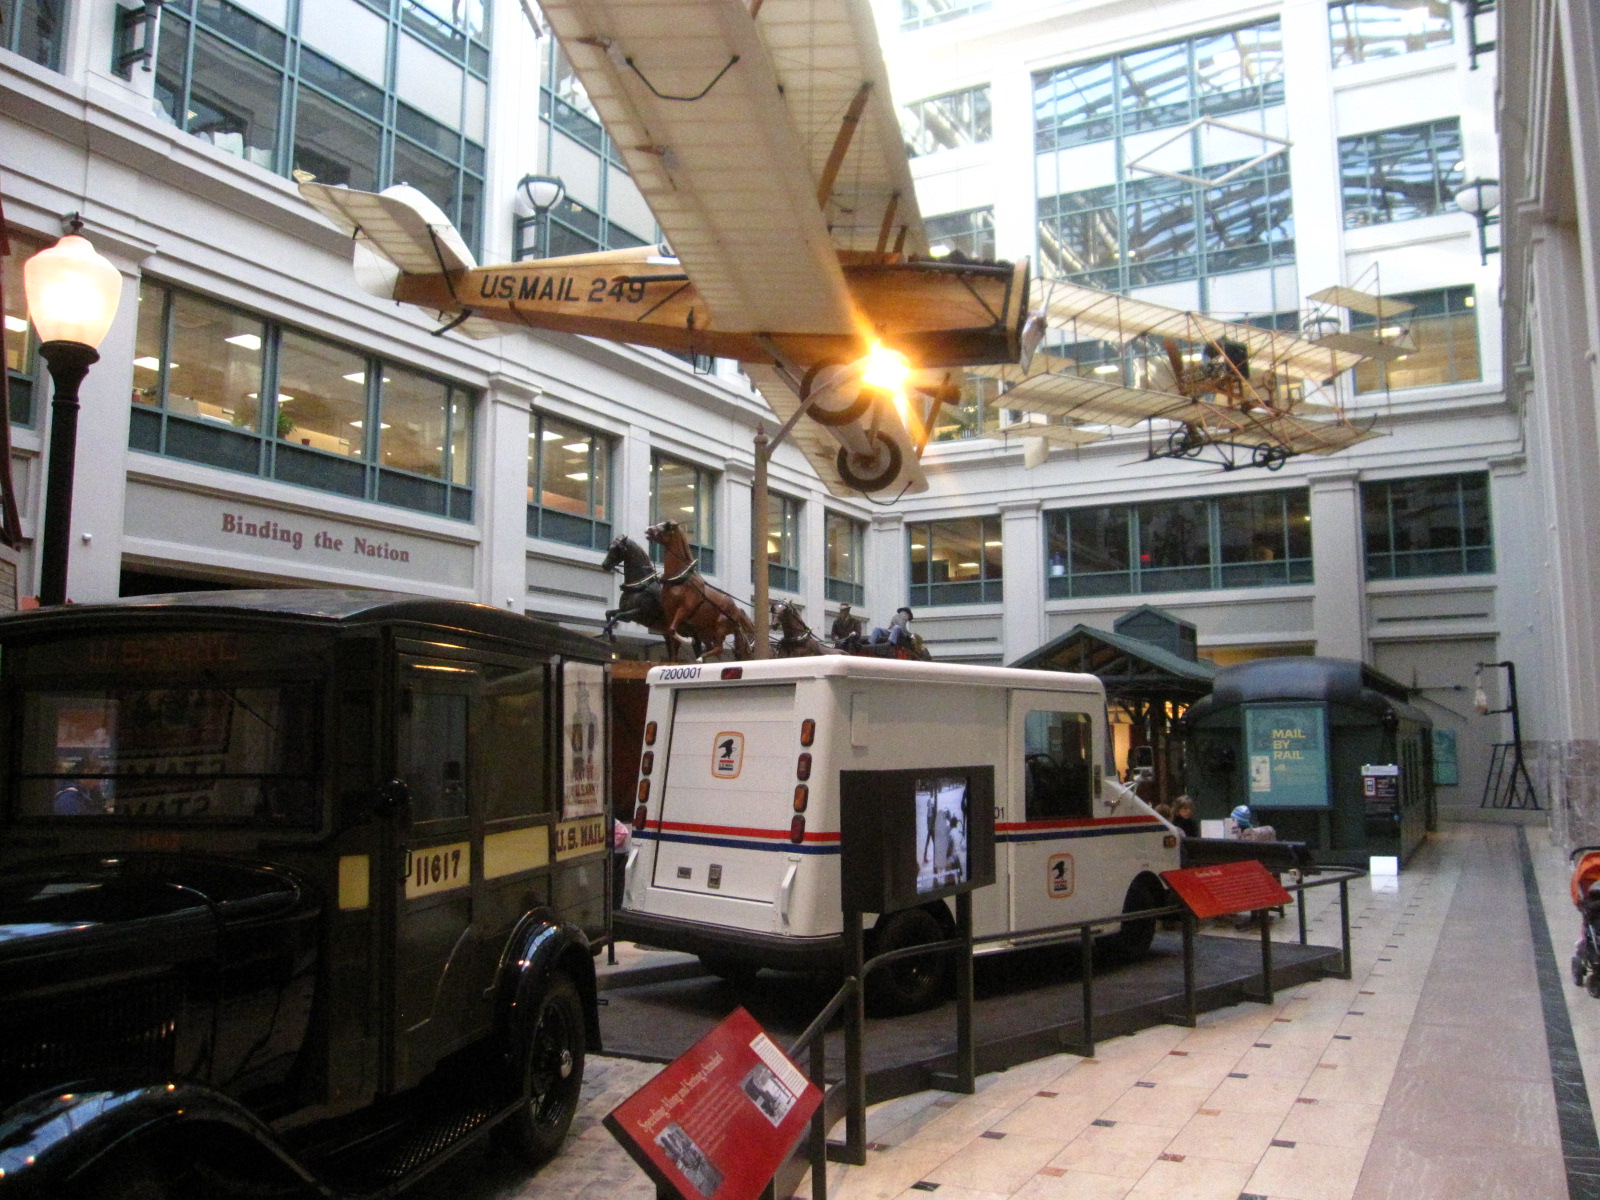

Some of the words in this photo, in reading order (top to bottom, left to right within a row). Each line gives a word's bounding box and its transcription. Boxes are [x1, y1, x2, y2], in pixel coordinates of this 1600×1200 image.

[517, 275, 580, 302] MAIL
[587, 278, 646, 303] 249
[222, 512, 303, 550] Binding
[314, 530, 343, 552] the
[354, 536, 410, 562] Nation
[659, 667, 702, 680] 7200001
[1272, 729, 1306, 739] MAIL
[1273, 740, 1291, 749] BY
[1273, 751, 1305, 760] RAIL
[580, 823, 605, 847] MAIL
[416, 850, 461, 887] 11617
